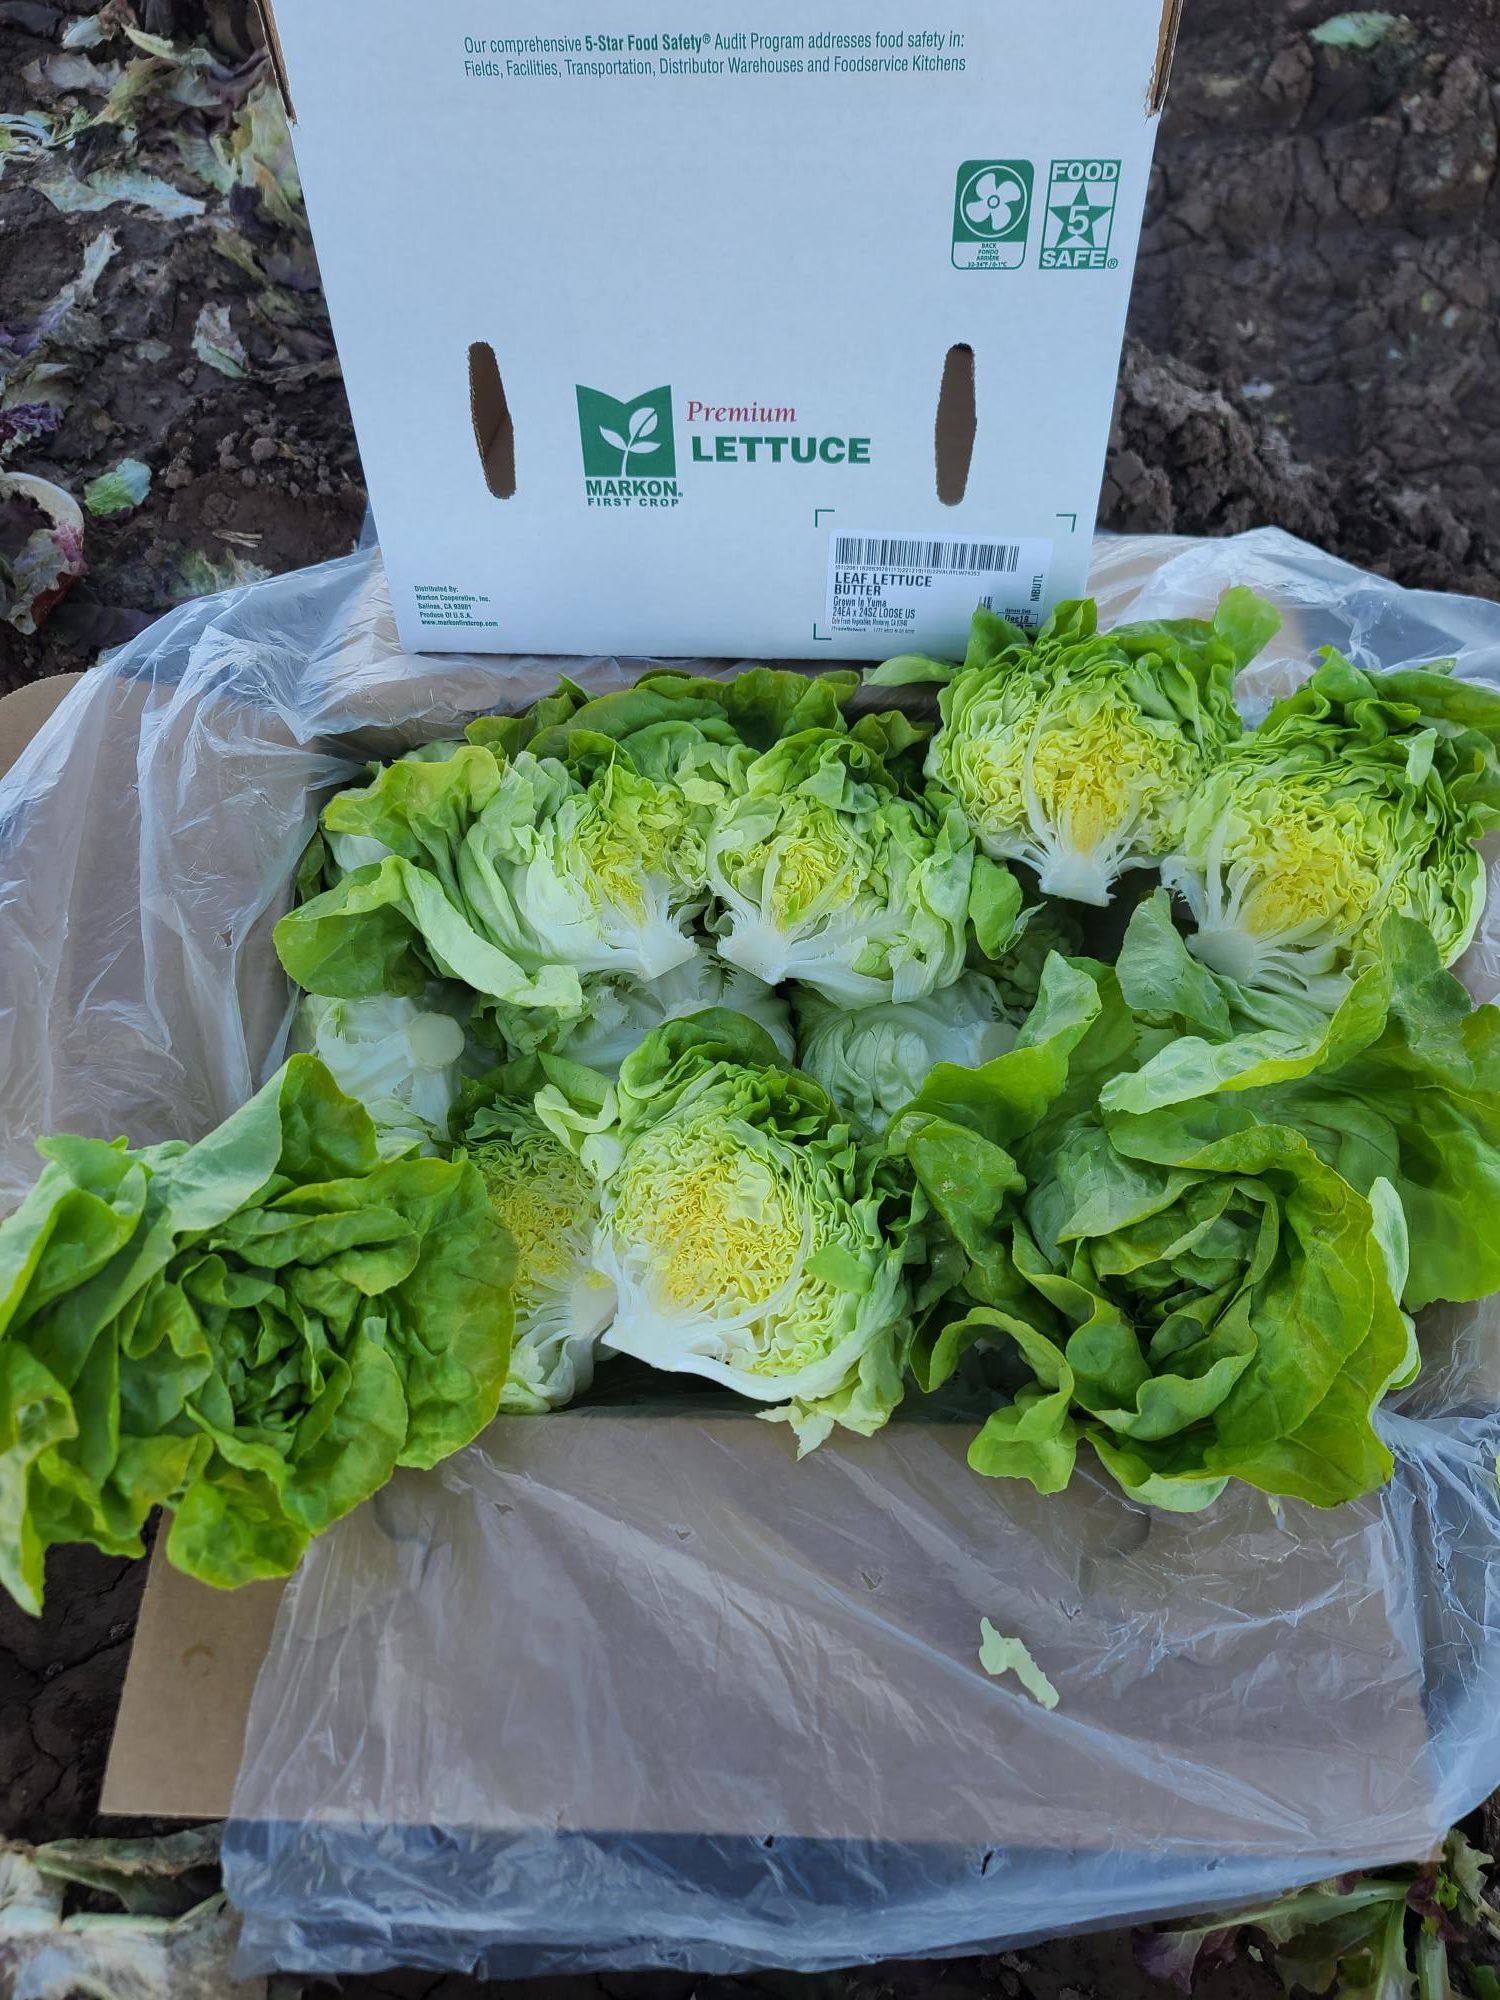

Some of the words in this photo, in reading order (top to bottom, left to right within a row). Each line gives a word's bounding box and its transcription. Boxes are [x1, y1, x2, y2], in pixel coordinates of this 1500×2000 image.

[464, 36, 486, 53] Our
[490, 35, 582, 56] comprehensive
[585, 34, 624, 52] 5-Star
[628, 34, 658, 51] Food
[715, 32, 747, 50] Audit
[750, 33, 804, 53] Program
[808, 31, 872, 49] addresses
[875, 31, 904, 48] food
[907, 31, 946, 51] safety
[949, 31, 965, 48] in:
[464, 60, 503, 78] Fields,
[506, 59, 562, 78] Facilities,
[564, 58, 656, 78] Transportation,
[659, 56, 725, 74] Distributor
[728, 56, 804, 73] Warehouses
[807, 56, 830, 73] and
[834, 55, 909, 73] Foodservice
[912, 55, 966, 72] Kitchens
[1051, 162, 1118, 181] FOOD
[1067, 205, 1090, 235] 5
[686, 401, 797, 423] Premium
[691, 436, 871, 464] LETTUCE
[587, 498, 632, 507] FIRST
[638, 498, 679, 507] CROP
[835, 571, 868, 585] LEAF
[873, 573, 933, 588] LETTUCE
[1029, 573, 1044, 602] MBUTL
[834, 584, 881, 596] BUTTER
[833, 596, 856, 607] Grown
[867, 597, 887, 608] Yuma
[832, 606, 851, 617] 24EA
[879, 608, 904, 619] LOOSE
[905, 608, 916, 619] US
